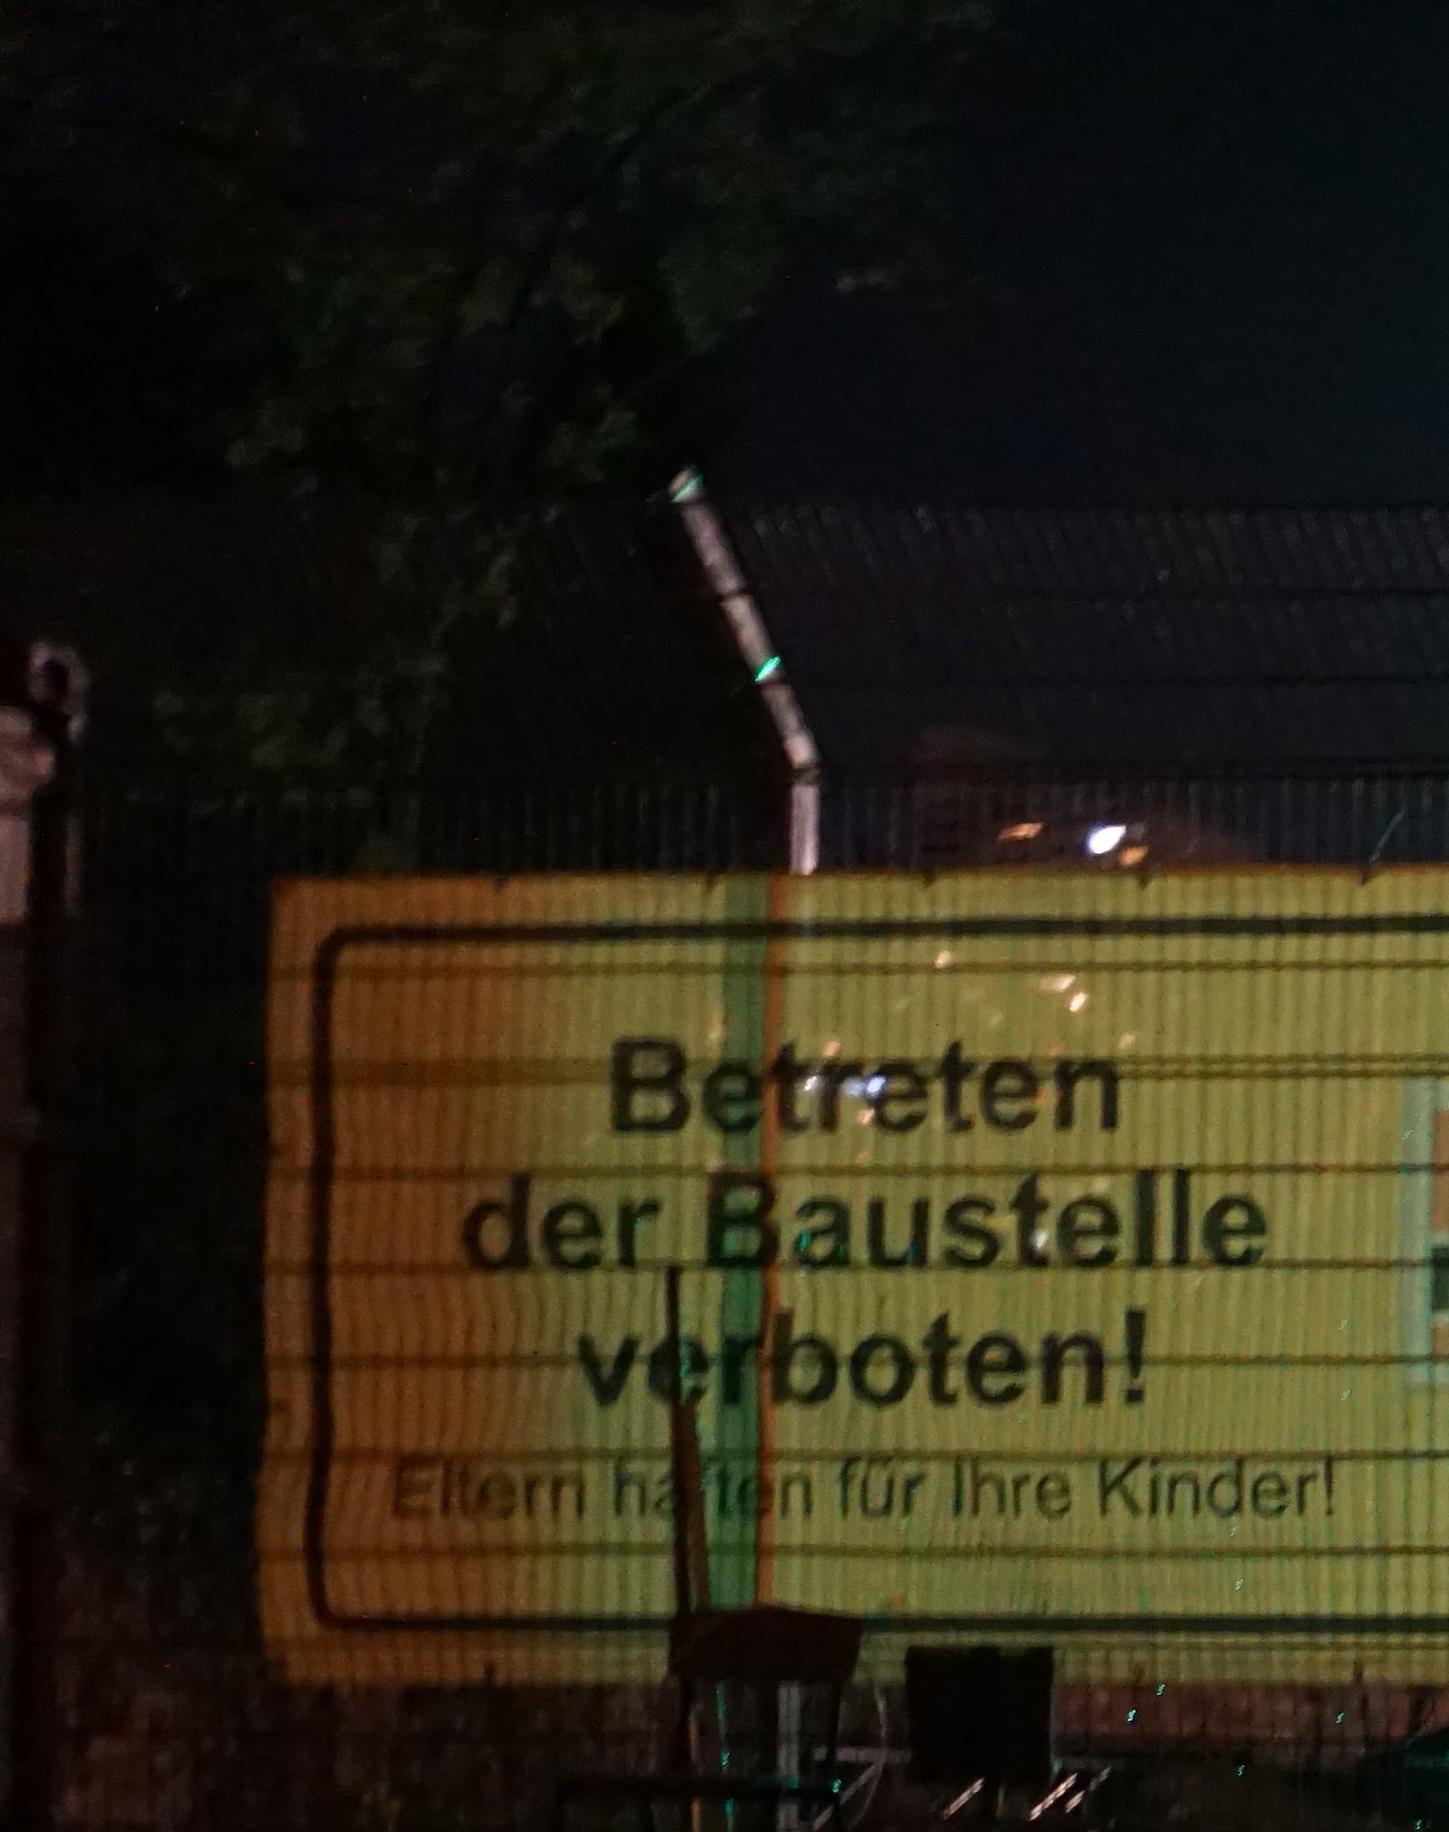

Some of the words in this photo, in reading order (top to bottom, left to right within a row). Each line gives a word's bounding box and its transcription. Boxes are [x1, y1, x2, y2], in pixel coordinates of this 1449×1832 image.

[609, 1036, 1119, 1136] Betreten
[461, 1172, 660, 1272] der
[706, 1166, 1269, 1272] Baustelle
[578, 1304, 1147, 1408] verboten!
[392, 1456, 585, 1522] Eltern
[613, 1454, 814, 1520] haten
[839, 1454, 924, 1520] für
[952, 1453, 1071, 1519] Ihre
[1101, 1452, 1334, 1520] Kinder!
